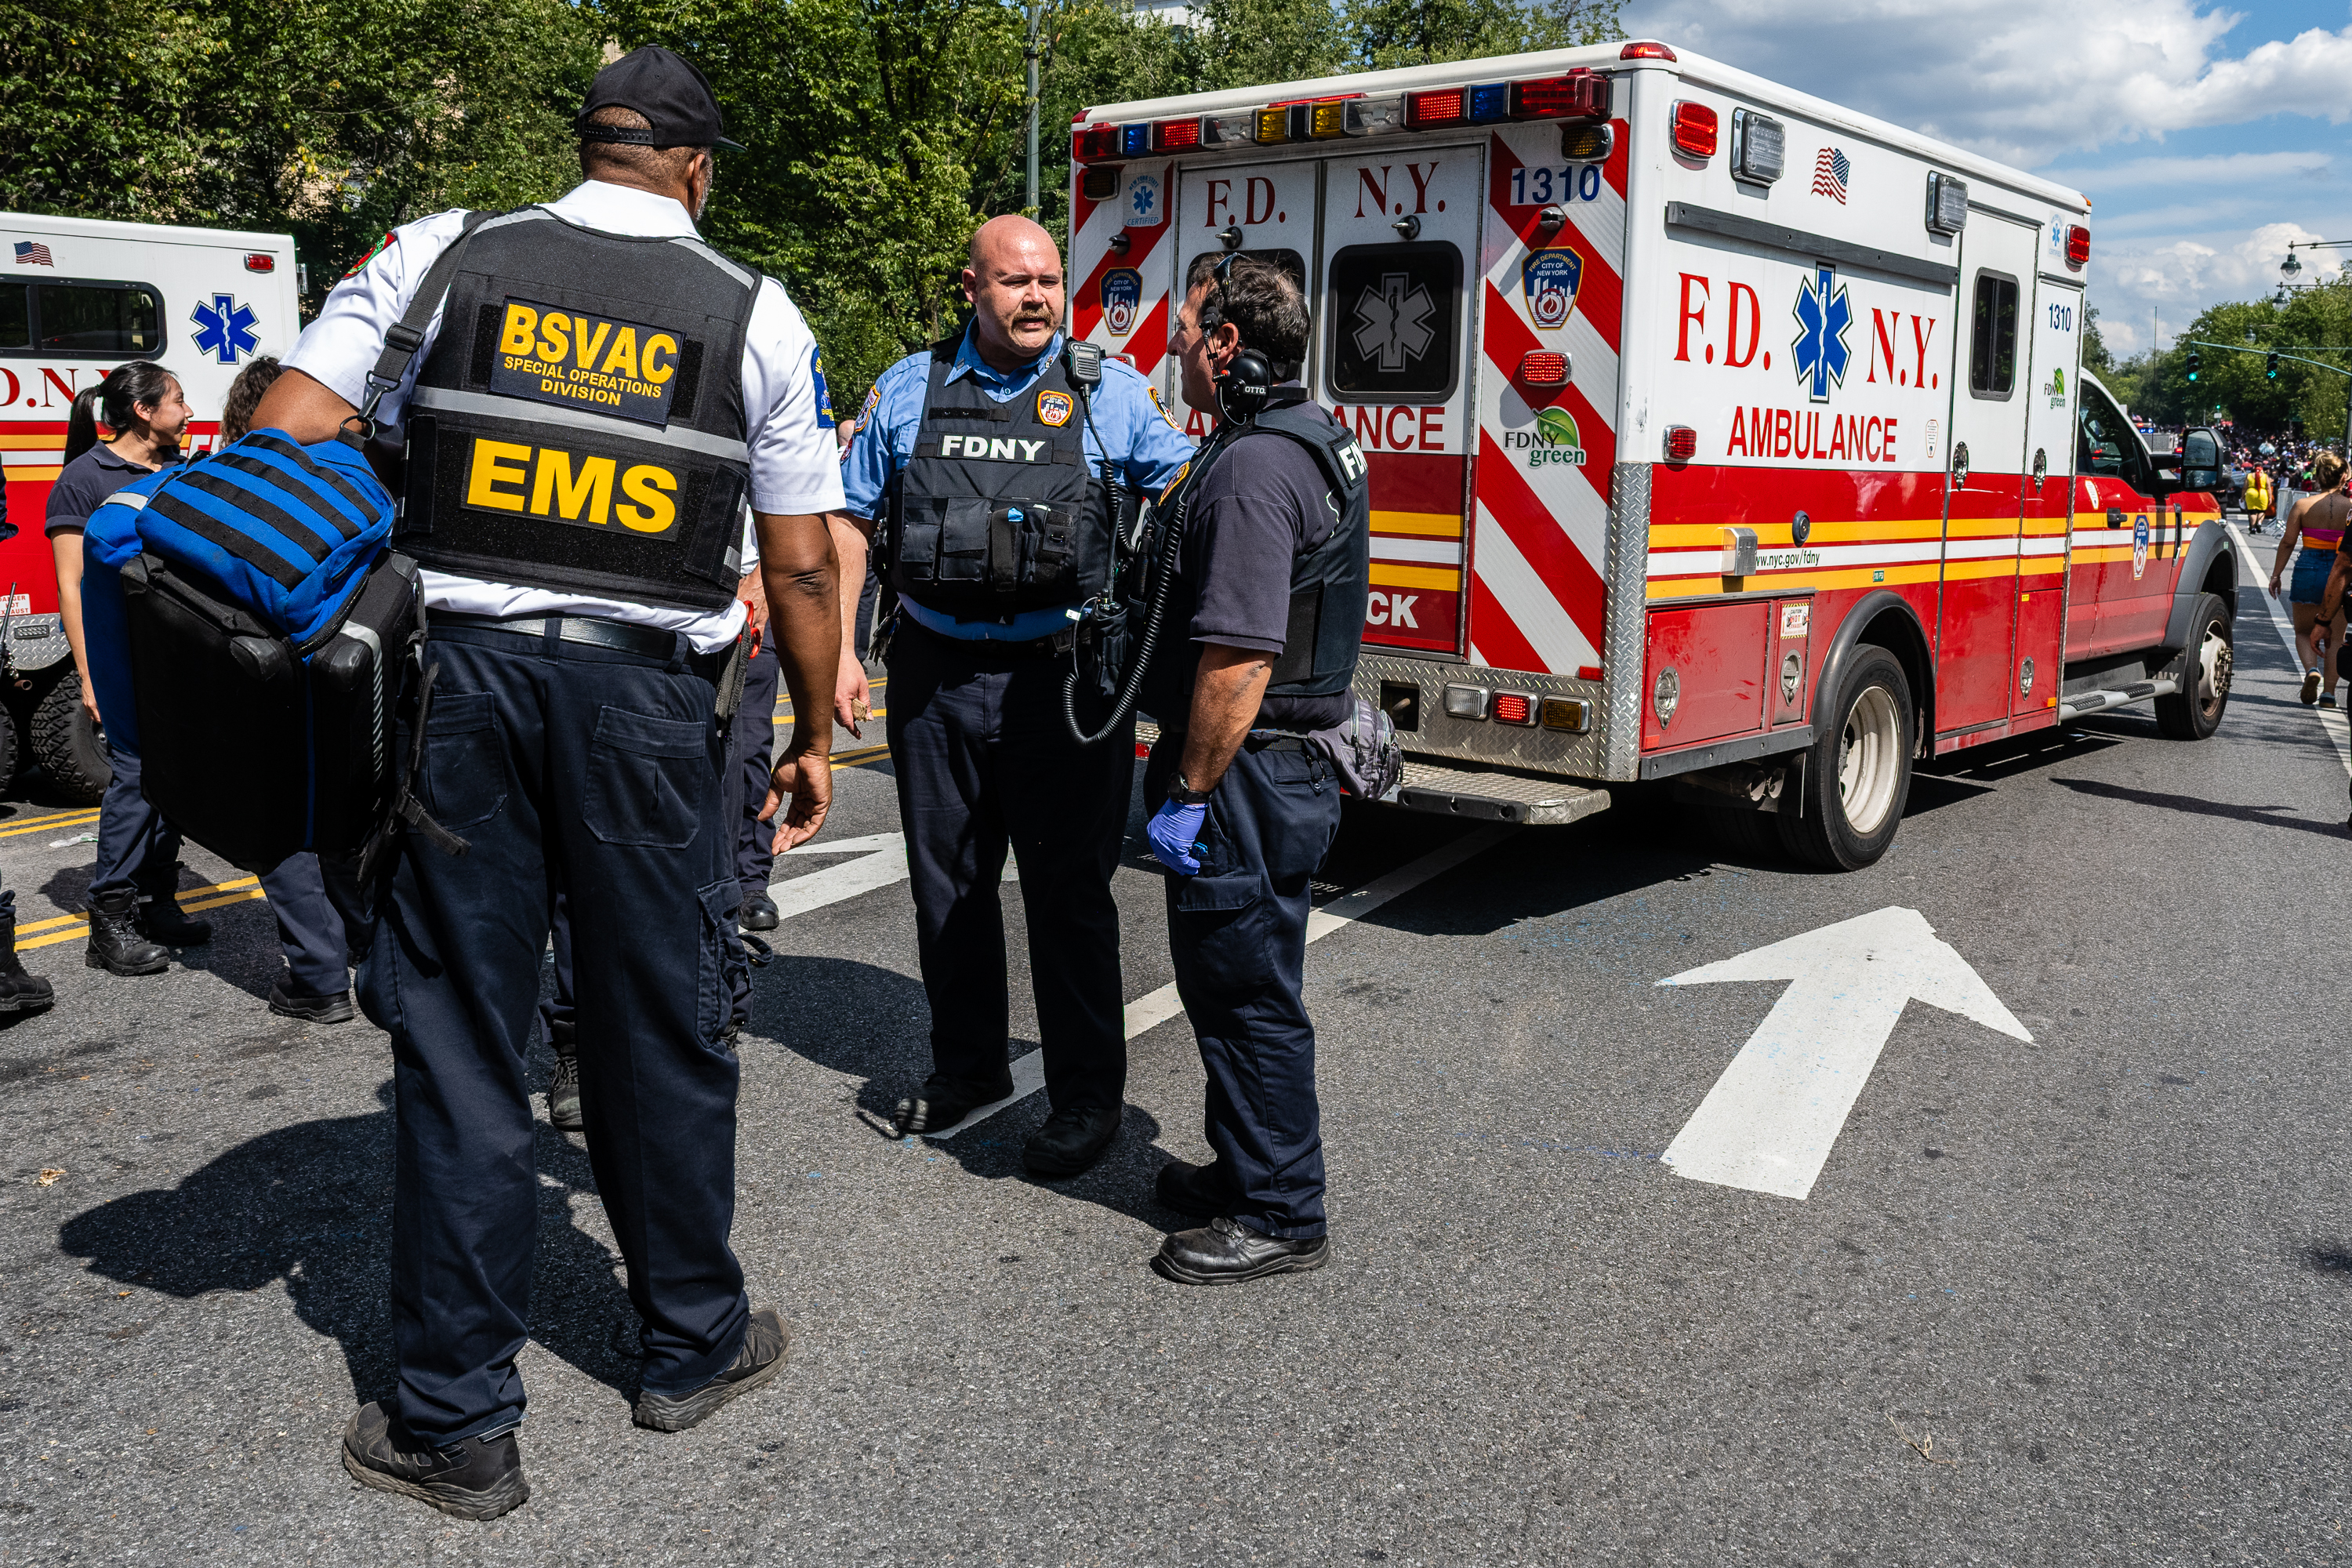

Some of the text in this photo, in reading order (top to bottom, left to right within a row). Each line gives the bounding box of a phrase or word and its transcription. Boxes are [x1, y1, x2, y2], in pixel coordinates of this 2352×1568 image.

[1129, 180, 1138, 191] NEW
[1149, 176, 1159, 188] STATE
[1204, 162, 1446, 227] F.D. N.Y.
[1512, 164, 1600, 204] 1310
[1127, 216, 1159, 226] CERTIFIED
[1529, 253, 1577, 272] FIRE DEPARTMENT
[1105, 272, 1138, 288] FIRE DEPARTMENT
[1674, 272, 1938, 390] F.D. N.Y.
[2049, 303, 2071, 332] 1310
[499, 303, 677, 384] BSVAC
[504, 357, 662, 398] SPECIAL OPERATIONS
[2044, 383, 2060, 397] FDNY
[540, 379, 621, 406] DIVISION
[2050, 397, 2065, 409] green
[1504, 432, 1560, 448] FDNY
[1726, 406, 1897, 463] AMBULANCE
[942, 435, 1046, 462] FDNY
[1530, 449, 1584, 466] green
[467, 438, 677, 533] EMS
